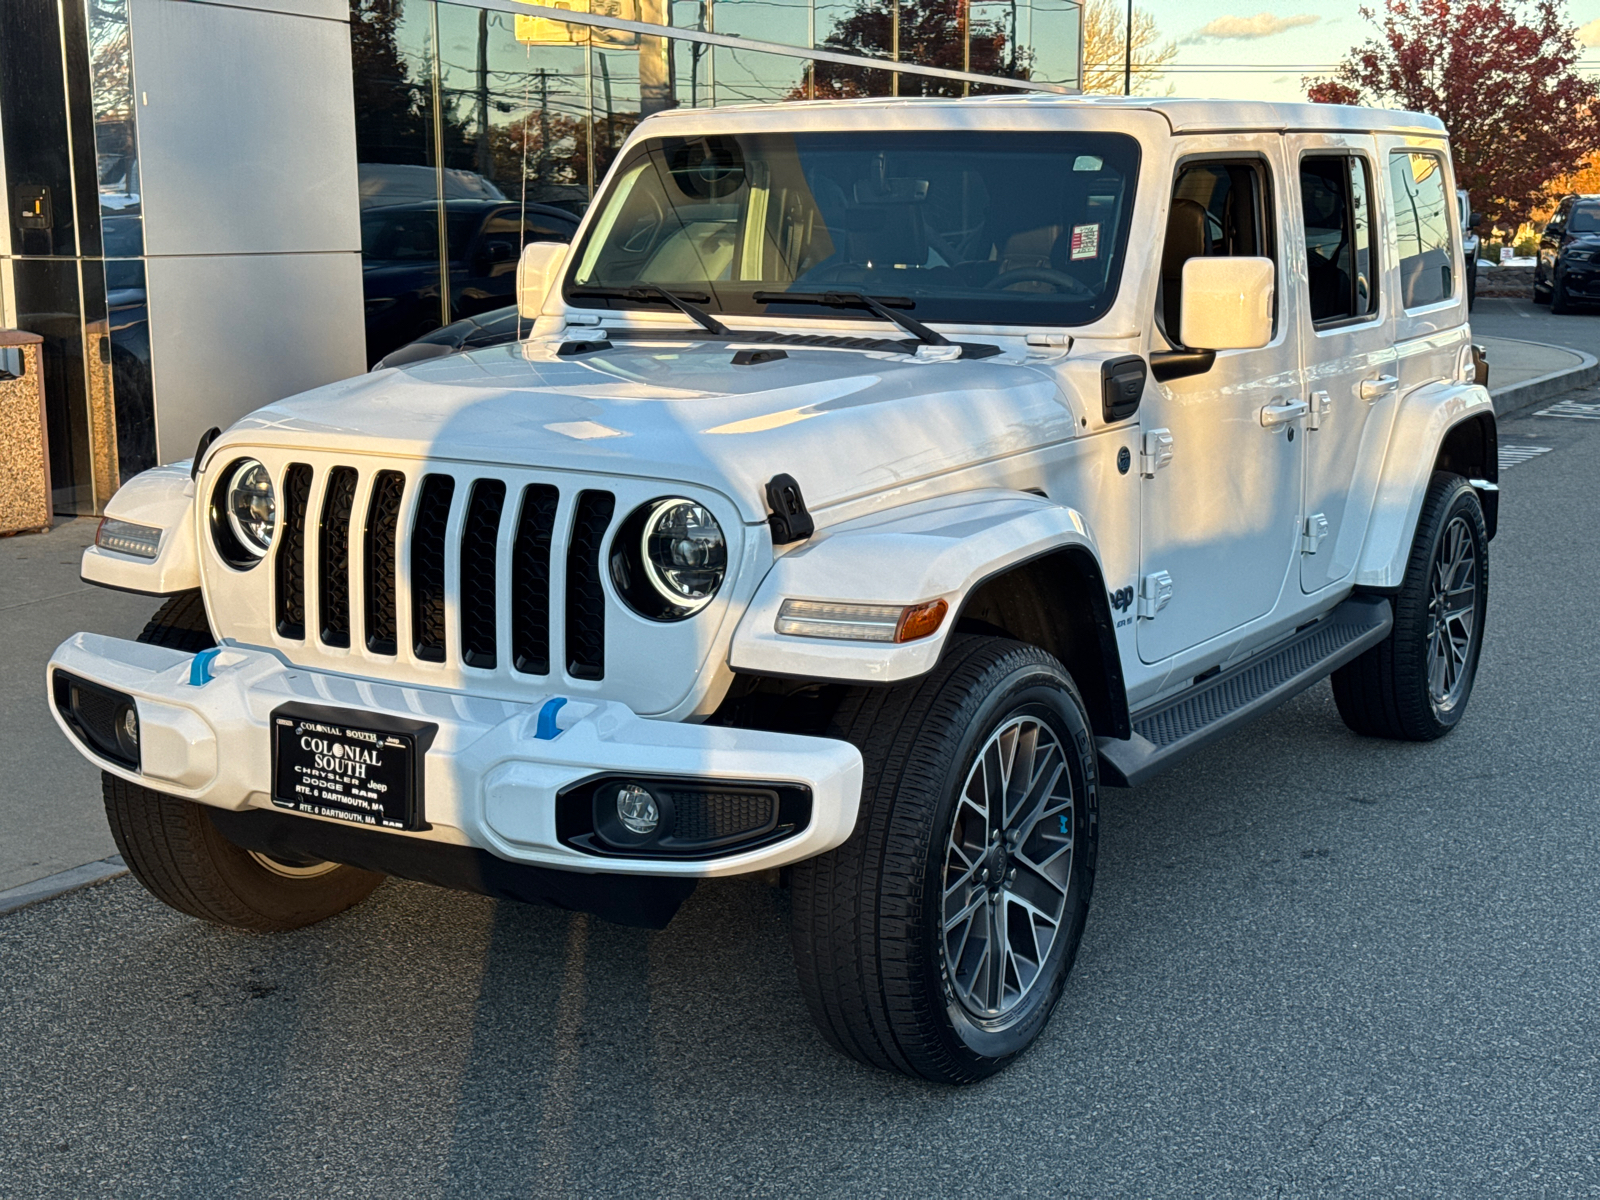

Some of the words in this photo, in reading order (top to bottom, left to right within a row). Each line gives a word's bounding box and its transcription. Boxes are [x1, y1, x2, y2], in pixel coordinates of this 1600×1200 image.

[345, 729, 377, 741] SOUTH
[300, 736, 382, 766] COLONIAL
[294, 765, 360, 786] CHRYSLER
[314, 755, 366, 778] SOUTH
[302, 776, 344, 792] DODGE
[351, 788, 378, 799] RAM
[367, 779, 388, 793] Jeep
[295, 784, 312, 796] RTE.
[313, 789, 319, 797] 6
[322, 791, 370, 810] DARTMOUTH,
[371, 802, 384, 812] MA
[299, 803, 314, 813] RTE.
[314, 806, 319, 814] 6
[321, 807, 364, 823] DARTMOUTH,
[365, 815, 376, 825] MA
[382, 820, 403, 828] RAM
